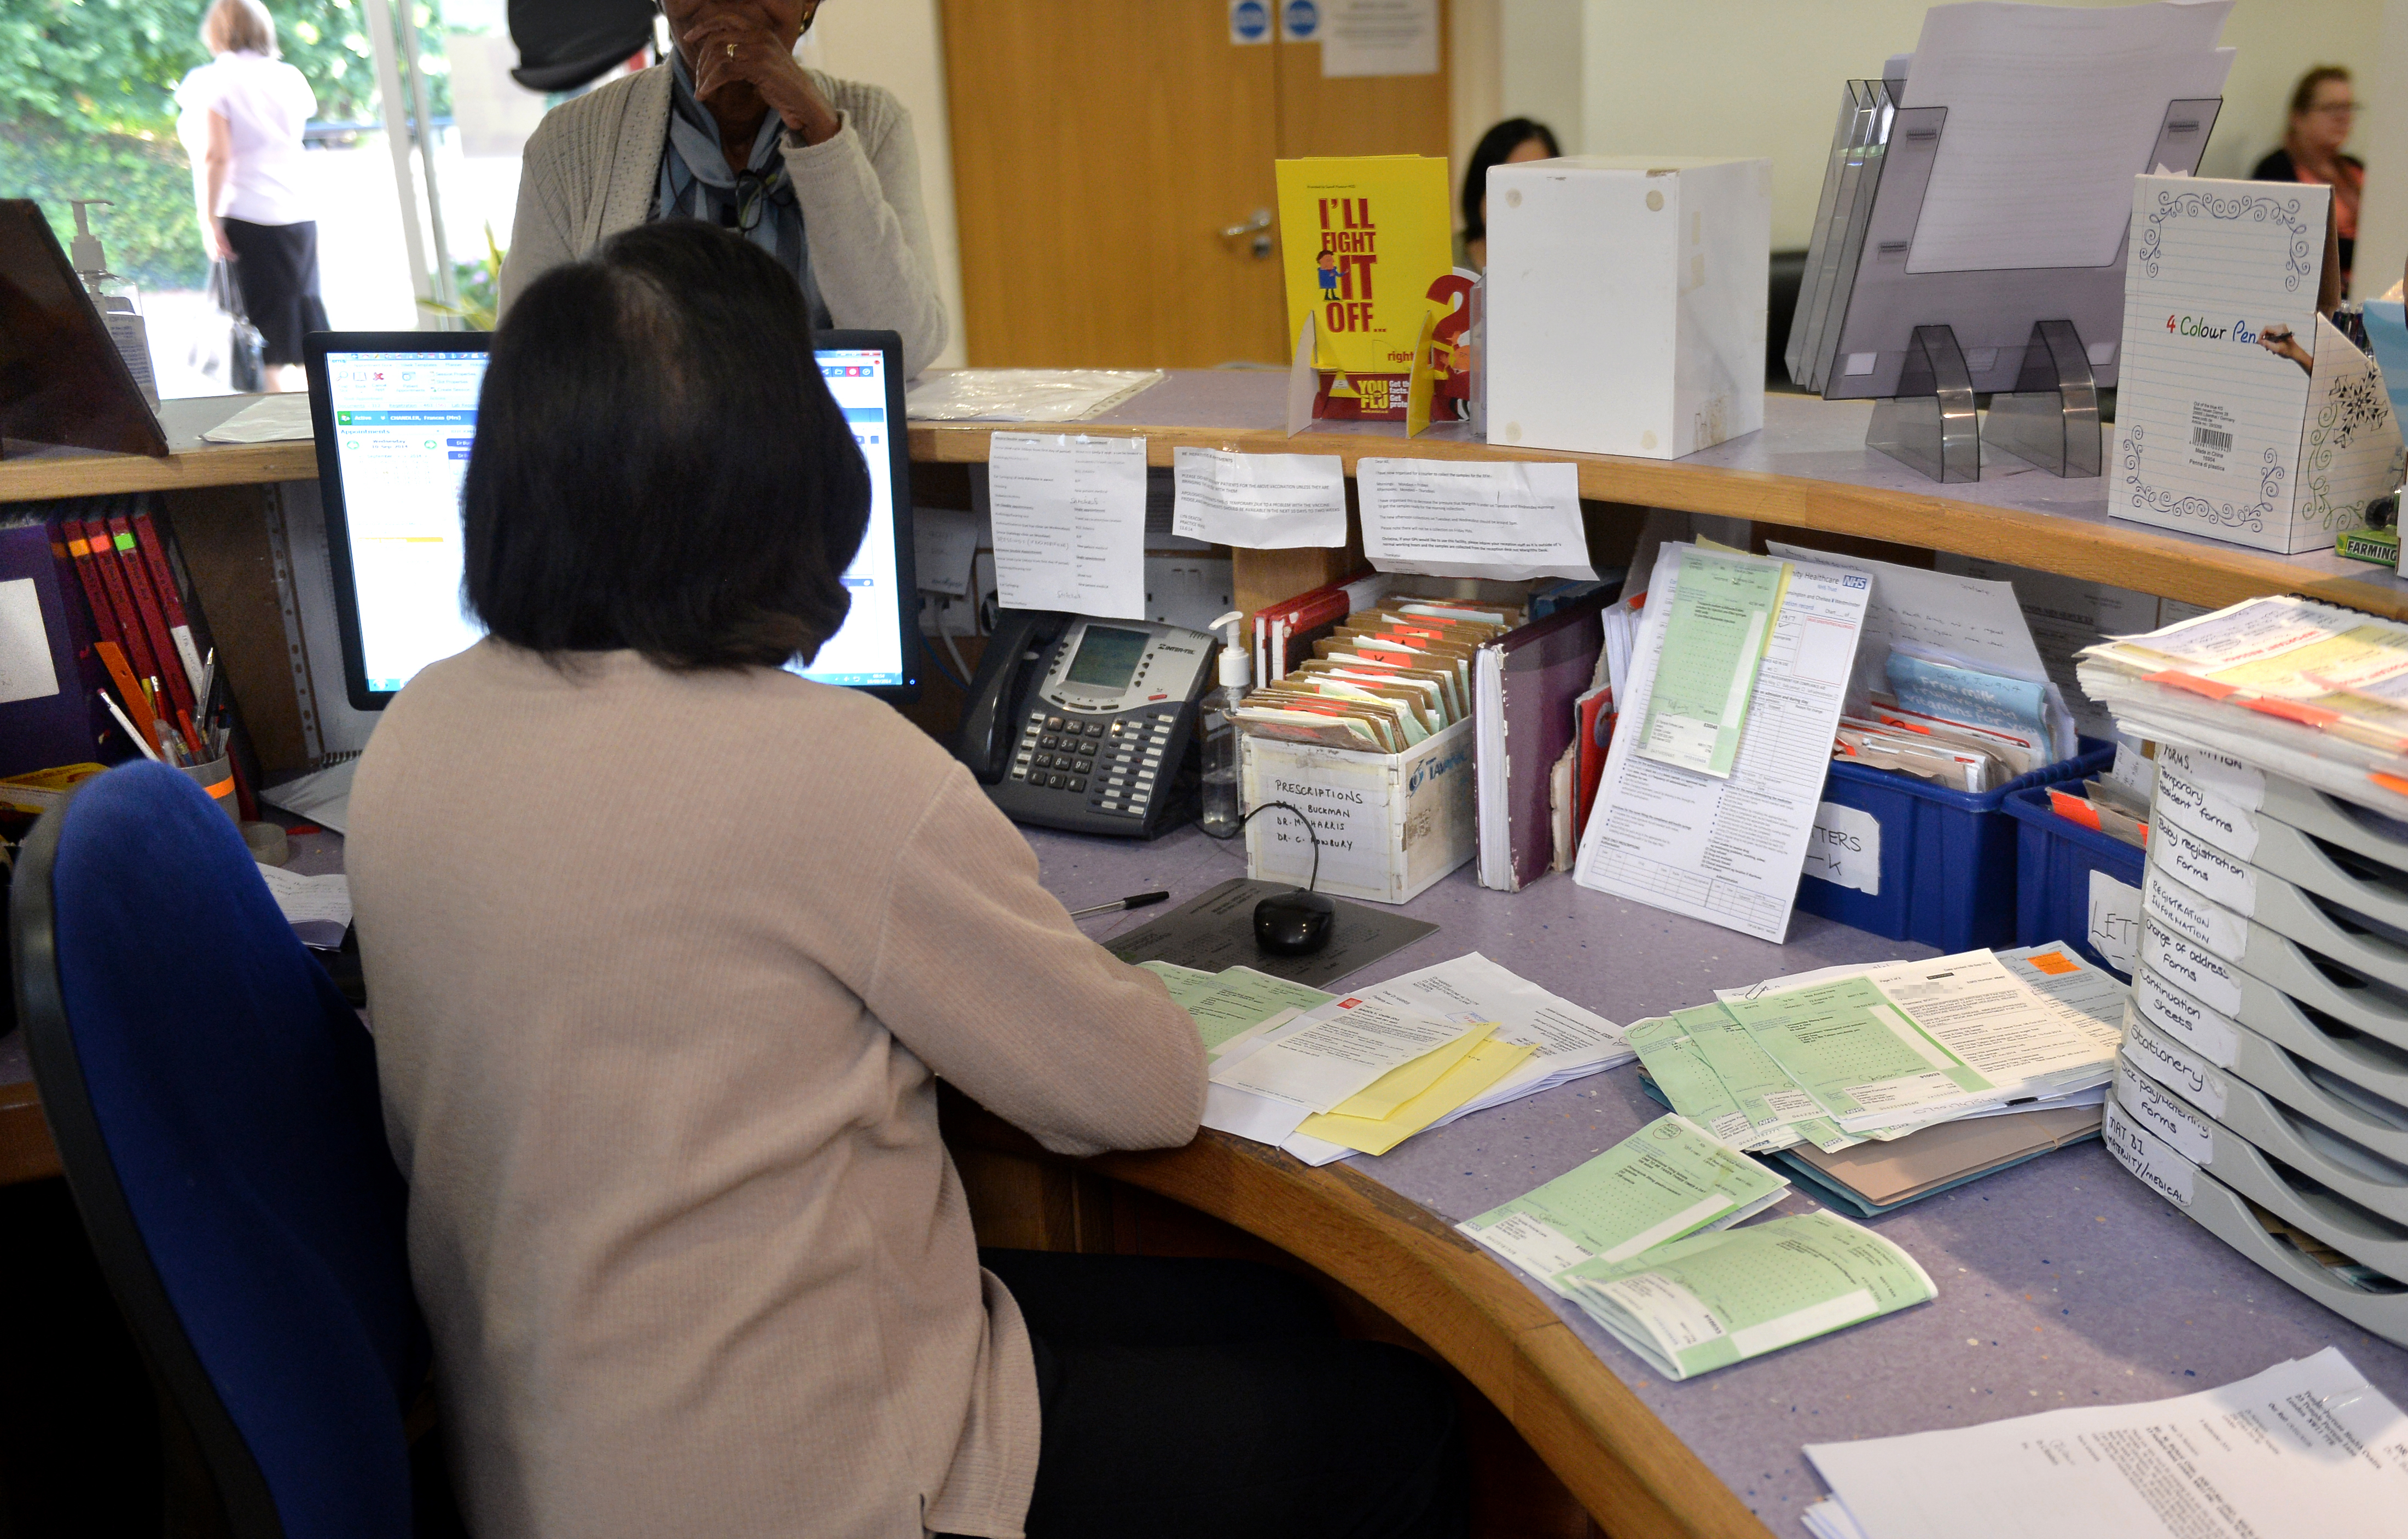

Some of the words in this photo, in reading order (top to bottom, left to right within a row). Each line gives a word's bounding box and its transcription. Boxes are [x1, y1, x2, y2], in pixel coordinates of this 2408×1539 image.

[1318, 198, 1376, 230] I'LL
[1321, 231, 1376, 252] FIGHT
[1339, 254, 1377, 300] IT
[2166, 315, 2175, 334] 4
[2180, 316, 2227, 339] Colour
[2232, 320, 2256, 343] Pen
[1357, 380, 1388, 394] YOU
[1361, 394, 1388, 409] FLU
[1806, 572, 1840, 584] Healthcare
[1843, 576, 1866, 589] NHS
[1275, 779, 1363, 804] PRESCRIPTIONS
[1308, 805, 1350, 818] BUCKMAN
[1311, 820, 1344, 831] HARRIS
[2181, 836, 2244, 879] registration
[2152, 880, 2210, 929] REGISTRATION
[2151, 897, 2210, 944] INFORMATION
[2139, 968, 2201, 1020] Continuation
[2131, 1024, 2203, 1093] Stationery
